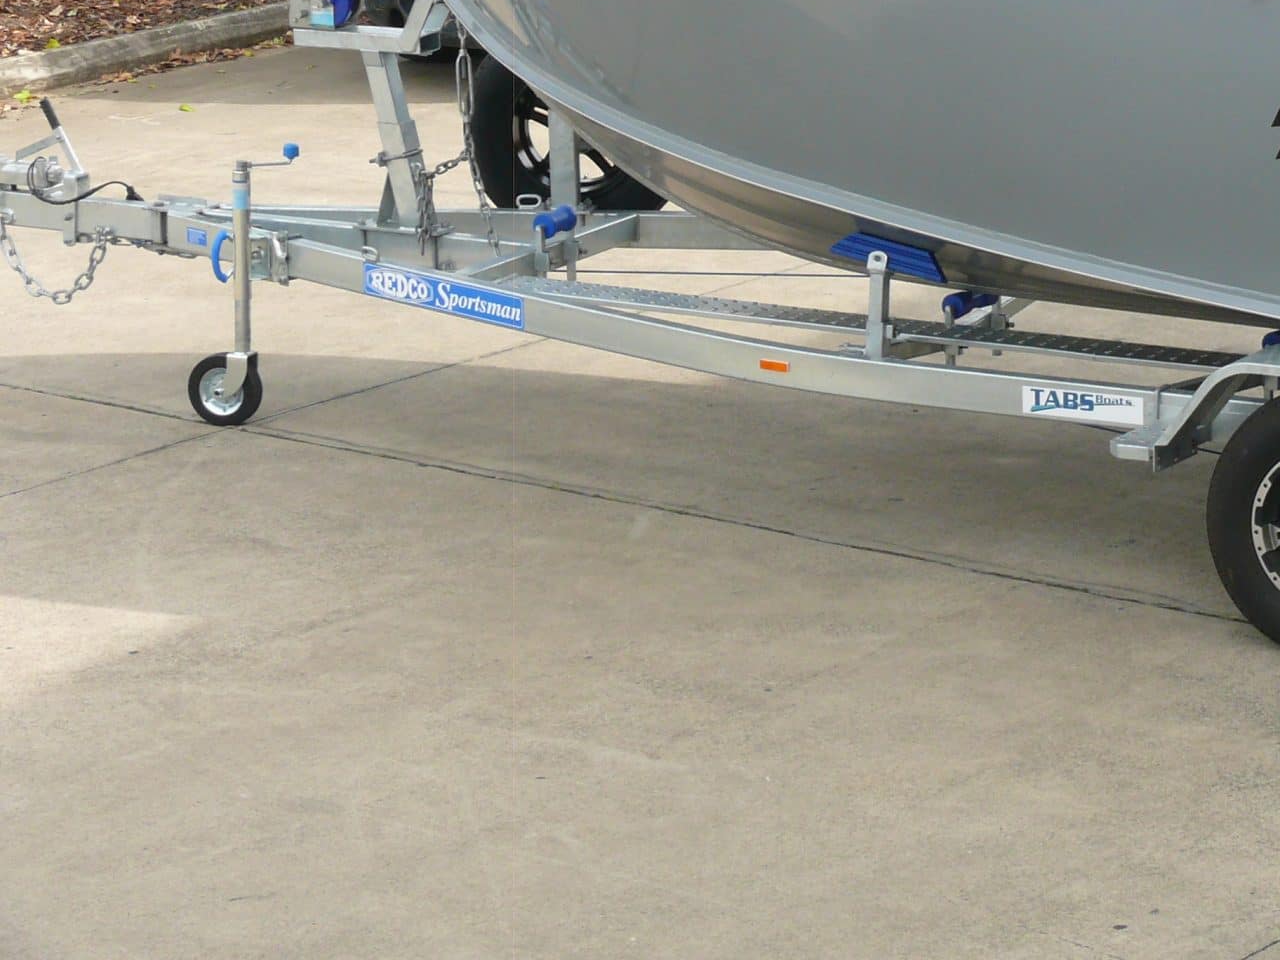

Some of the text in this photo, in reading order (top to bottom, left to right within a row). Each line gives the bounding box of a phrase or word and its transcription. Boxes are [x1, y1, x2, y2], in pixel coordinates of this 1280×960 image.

[436, 283, 521, 321] Sportsman
[1030, 388, 1132, 411] TABS Boats
